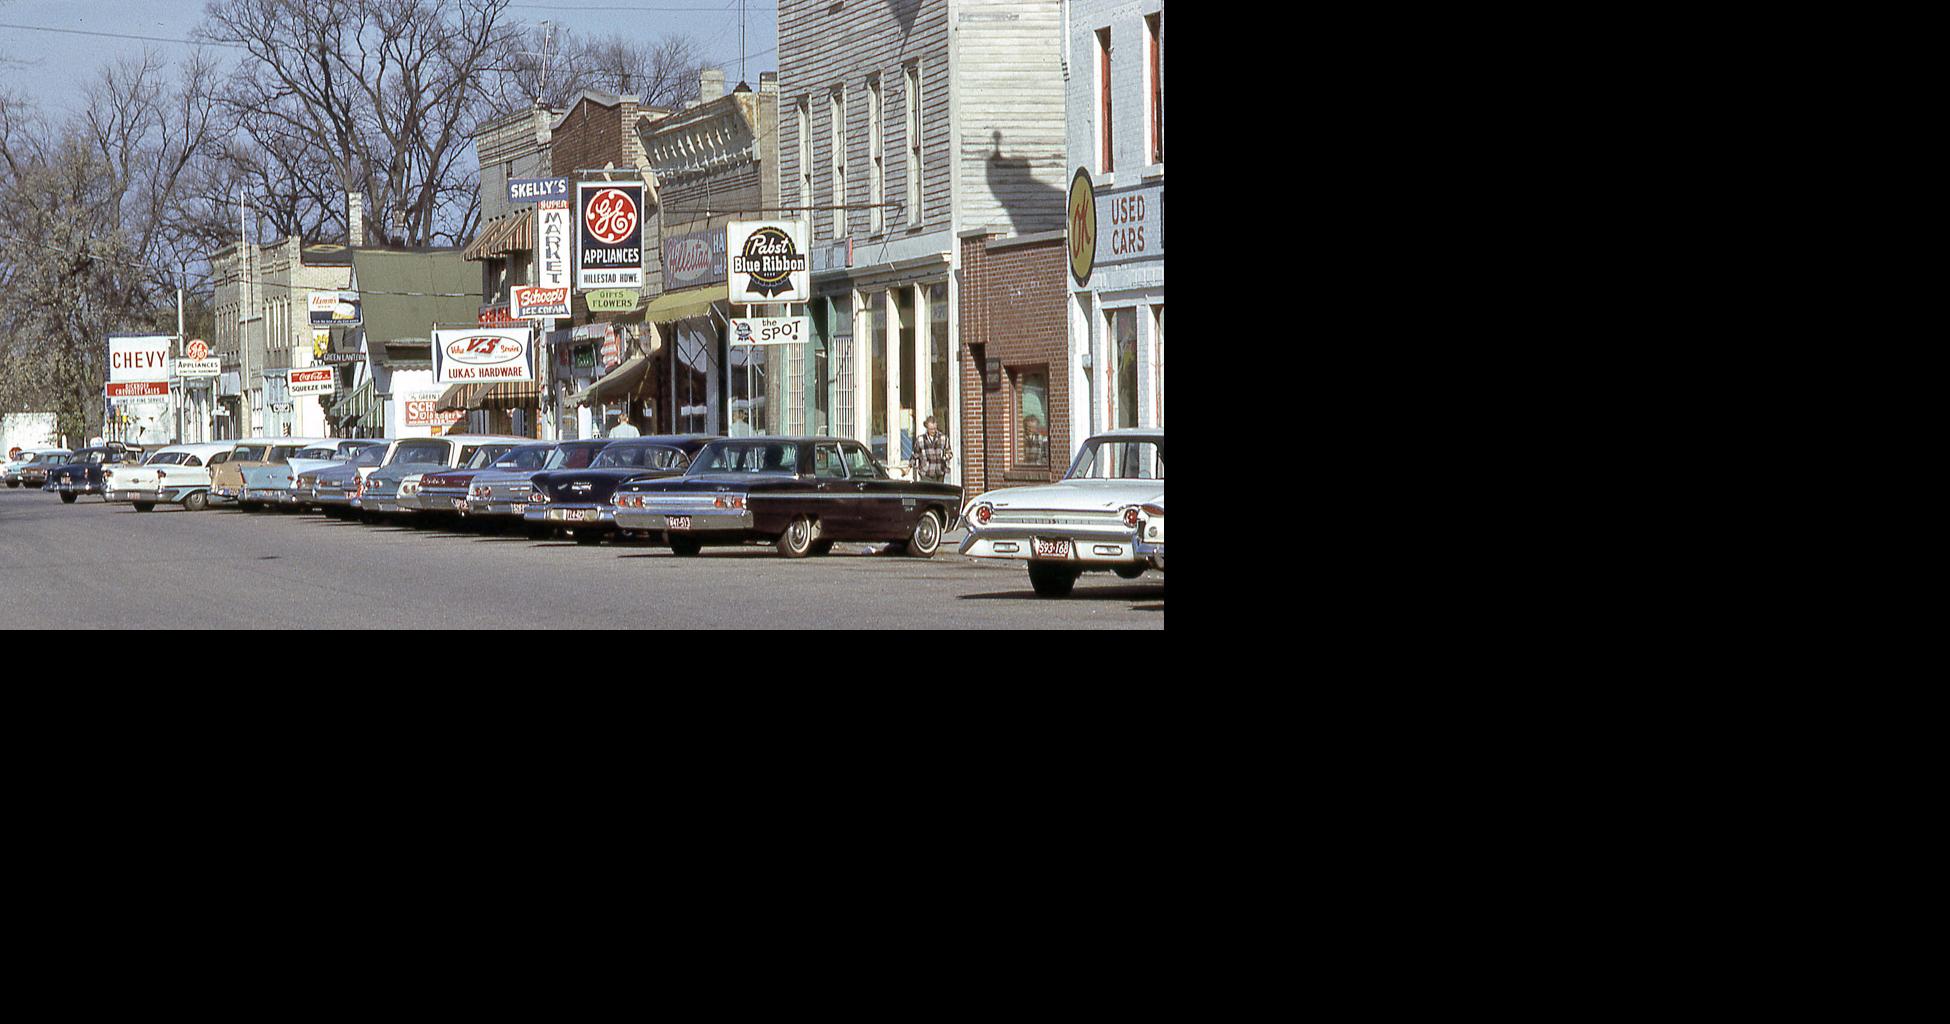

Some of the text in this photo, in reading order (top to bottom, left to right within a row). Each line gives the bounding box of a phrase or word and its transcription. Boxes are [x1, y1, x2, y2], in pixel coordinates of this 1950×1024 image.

[511, 180, 566, 198] SKELLY'S
[1112, 195, 1145, 225] USED
[545, 212, 562, 284] MARKET
[751, 235, 788, 255] Pabst
[1112, 226, 1145, 255] CARS
[584, 248, 639, 264] APPLIANCES
[734, 257, 760, 272] Blue
[762, 255, 804, 272] Ribbon
[584, 274, 617, 283] HILLESTAD
[520, 288, 564, 306] Schoep's
[593, 299, 632, 307] FLOWERS
[113, 351, 166, 368] CHEVY
[448, 367, 523, 378] LUKAS HARDWARE
